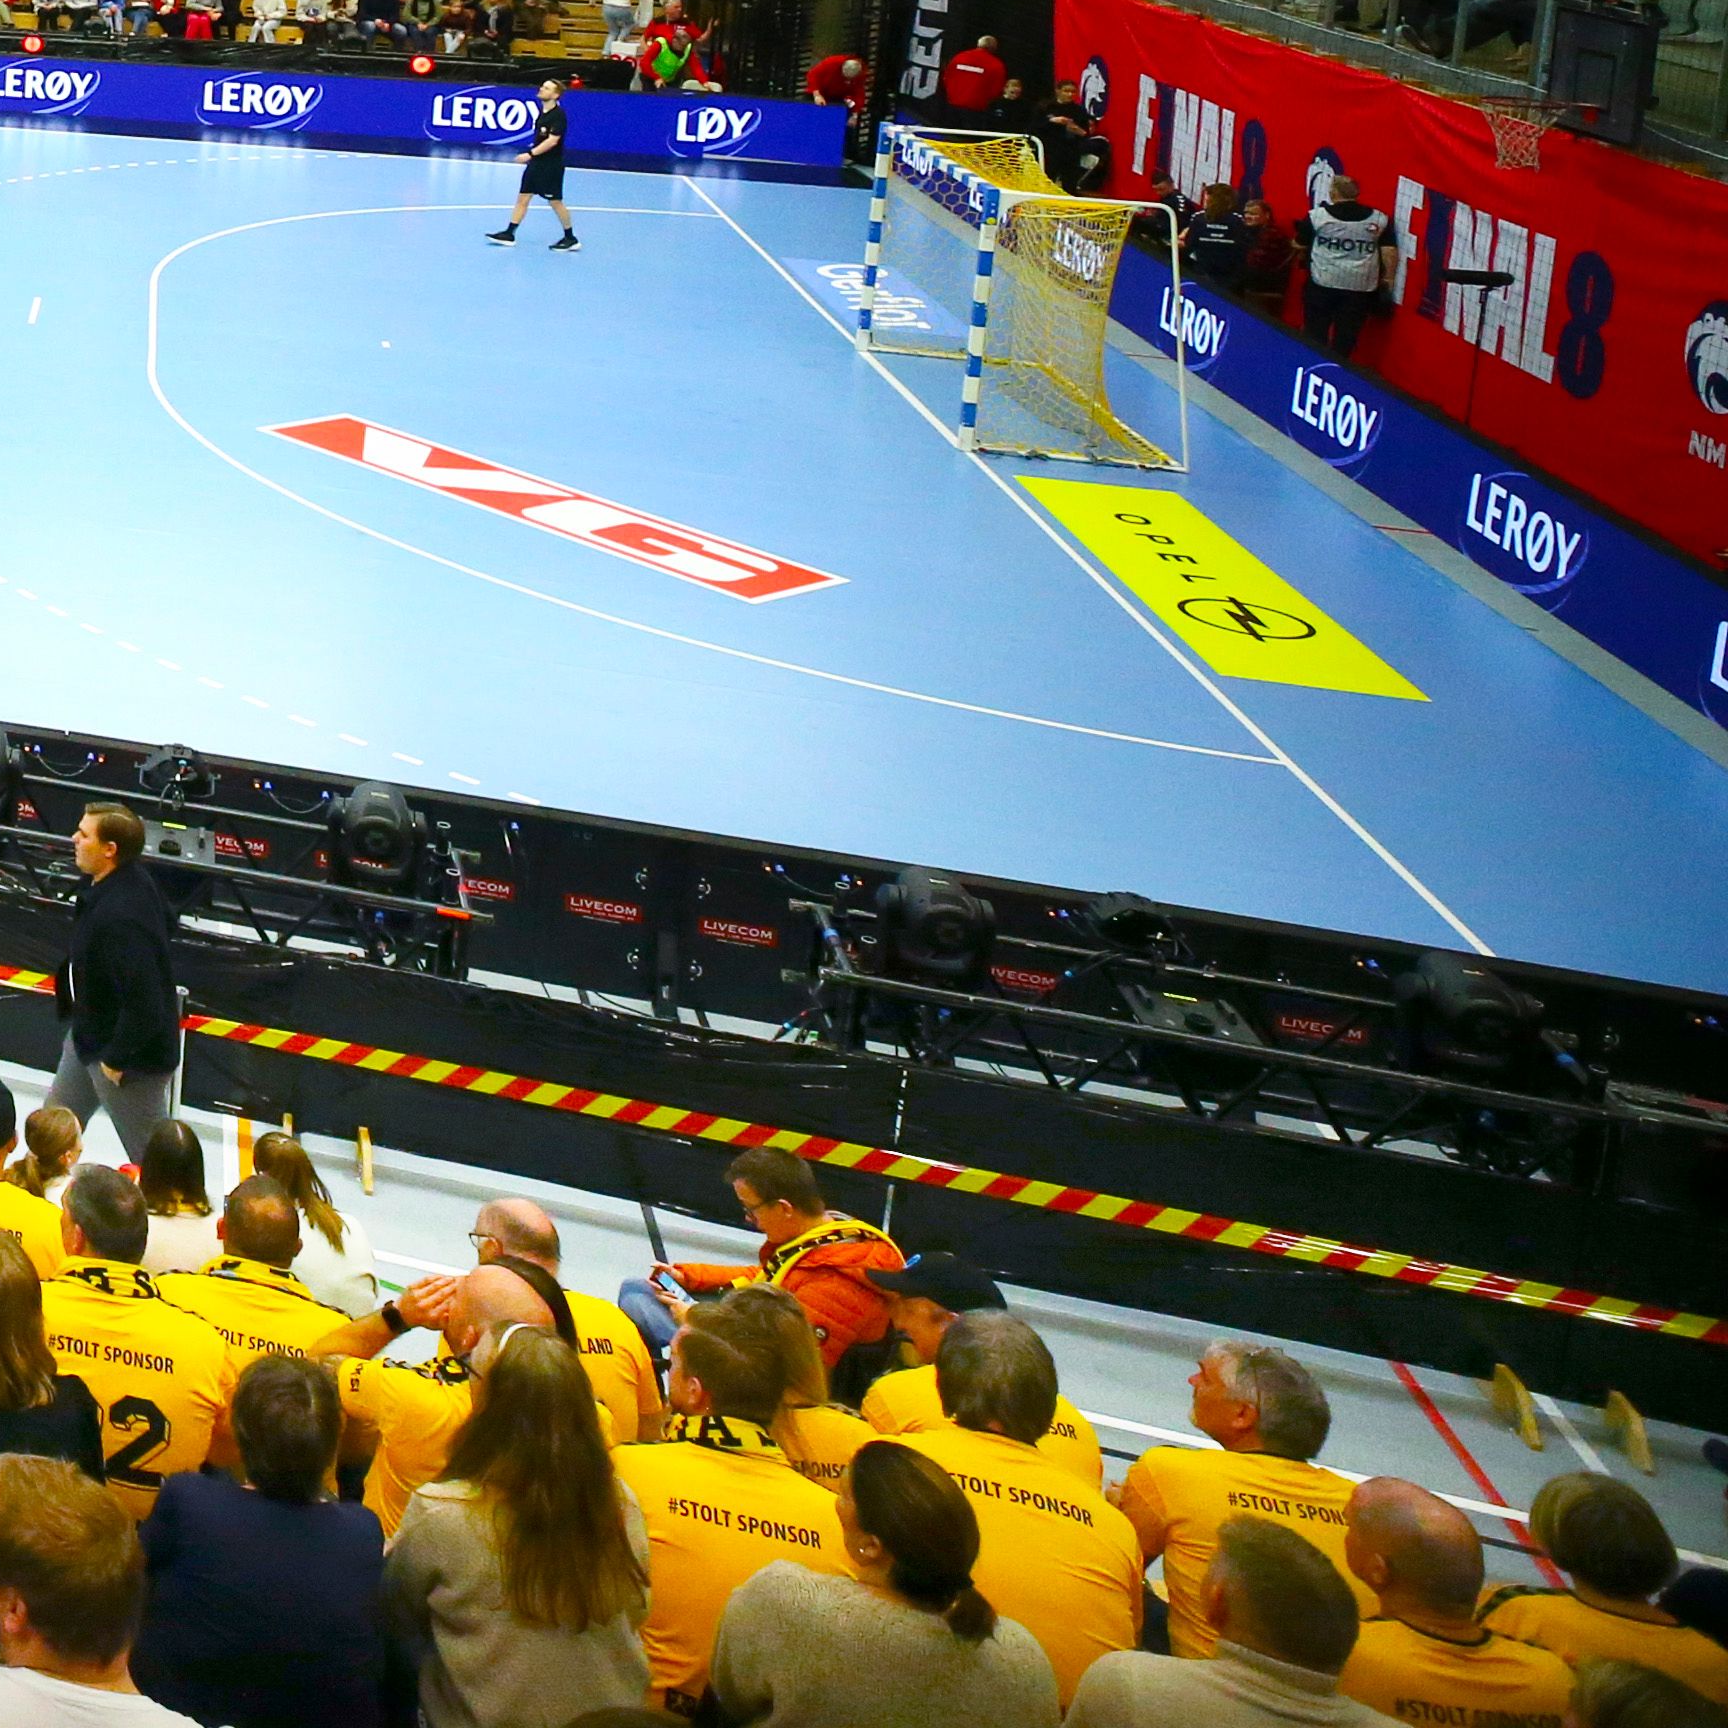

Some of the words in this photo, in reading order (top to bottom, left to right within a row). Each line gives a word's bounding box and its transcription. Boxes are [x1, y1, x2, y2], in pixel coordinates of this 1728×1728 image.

[203, 79, 315, 116] LERØY
[1317, 237, 1374, 254] PHOTO
[1291, 367, 1378, 453] LERØY
[362, 427, 780, 583] VG
[1466, 474, 1581, 580] LERØY
[1114, 512, 1216, 584] OPEL
[215, 836, 265, 853] VECOM
[466, 880, 510, 895] ECOM
[570, 896, 638, 917] LIVECOM
[702, 919, 775, 941] LIVECOM
[1280, 1016, 1363, 1040] LIVECM
[48, 1334, 100, 1358] #STOLT
[104, 1346, 174, 1374] SPONSOR
[248, 1335, 307, 1357] SPONSO
[579, 1338, 613, 1356] LAND
[99, 1395, 171, 1491] 2
[668, 1498, 731, 1528] #STOLT
[738, 1514, 821, 1550] SPONSOR
[1008, 1486, 1093, 1529] SPONSOR
[1228, 1491, 1291, 1518] #STOLT
[1296, 1503, 1346, 1527] SPON
[1395, 1698, 1468, 1727] #STOLT
